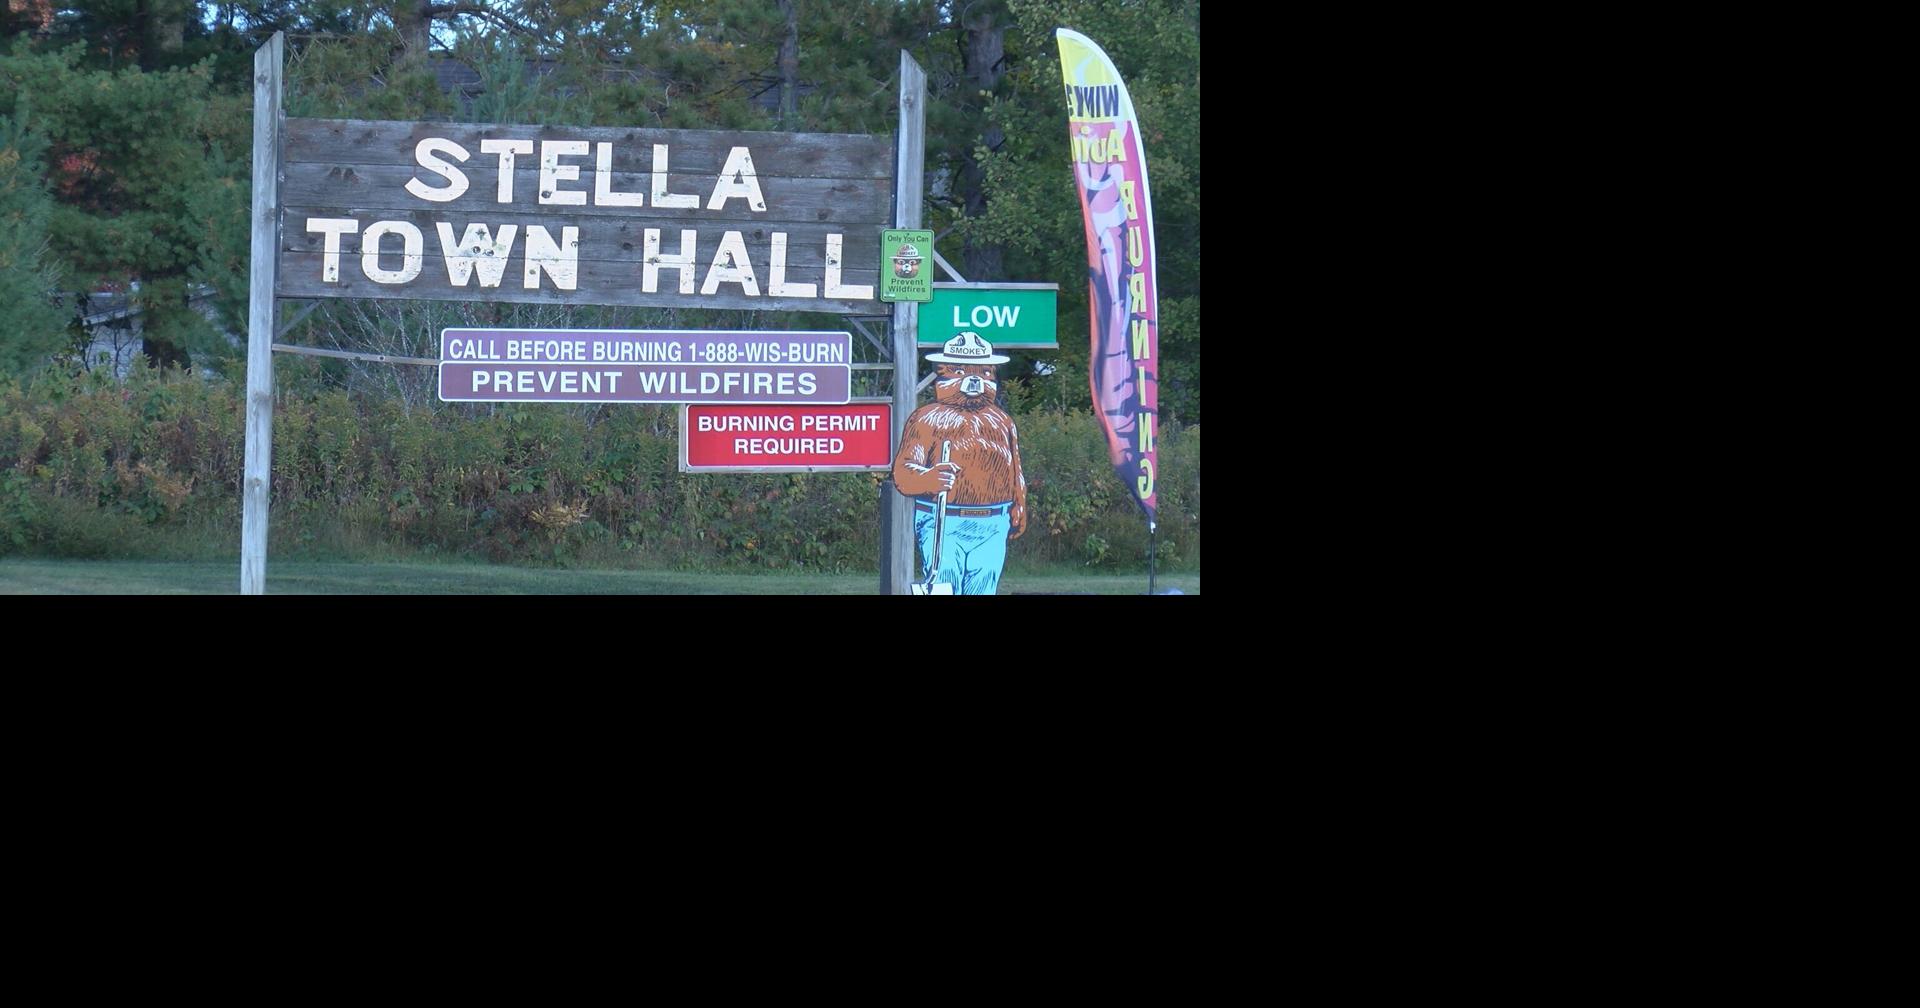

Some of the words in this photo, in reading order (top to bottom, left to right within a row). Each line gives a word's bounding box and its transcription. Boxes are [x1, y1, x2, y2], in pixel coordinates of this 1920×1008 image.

[404, 137, 767, 213] STELLA
[887, 234, 902, 243] Only
[904, 234, 915, 243] You
[916, 235, 929, 243] Can
[305, 217, 579, 291] TOWN
[641, 227, 874, 301] HALL
[888, 285, 926, 293] Wildfires
[891, 278, 924, 286] Prevent
[953, 305, 1021, 328] LOW
[449, 339, 501, 360] CALL
[507, 340, 587, 361] BEFORE
[593, 341, 682, 362] BURNING
[688, 342, 844, 363] 1-888-WIS-BURN
[949, 346, 987, 356] SMOKEY
[472, 371, 623, 393] PREVENT
[639, 371, 818, 395] WILDFIRES
[698, 415, 795, 432] BURNING
[801, 415, 881, 432] PERMIT
[734, 438, 845, 454] REQUIRED
